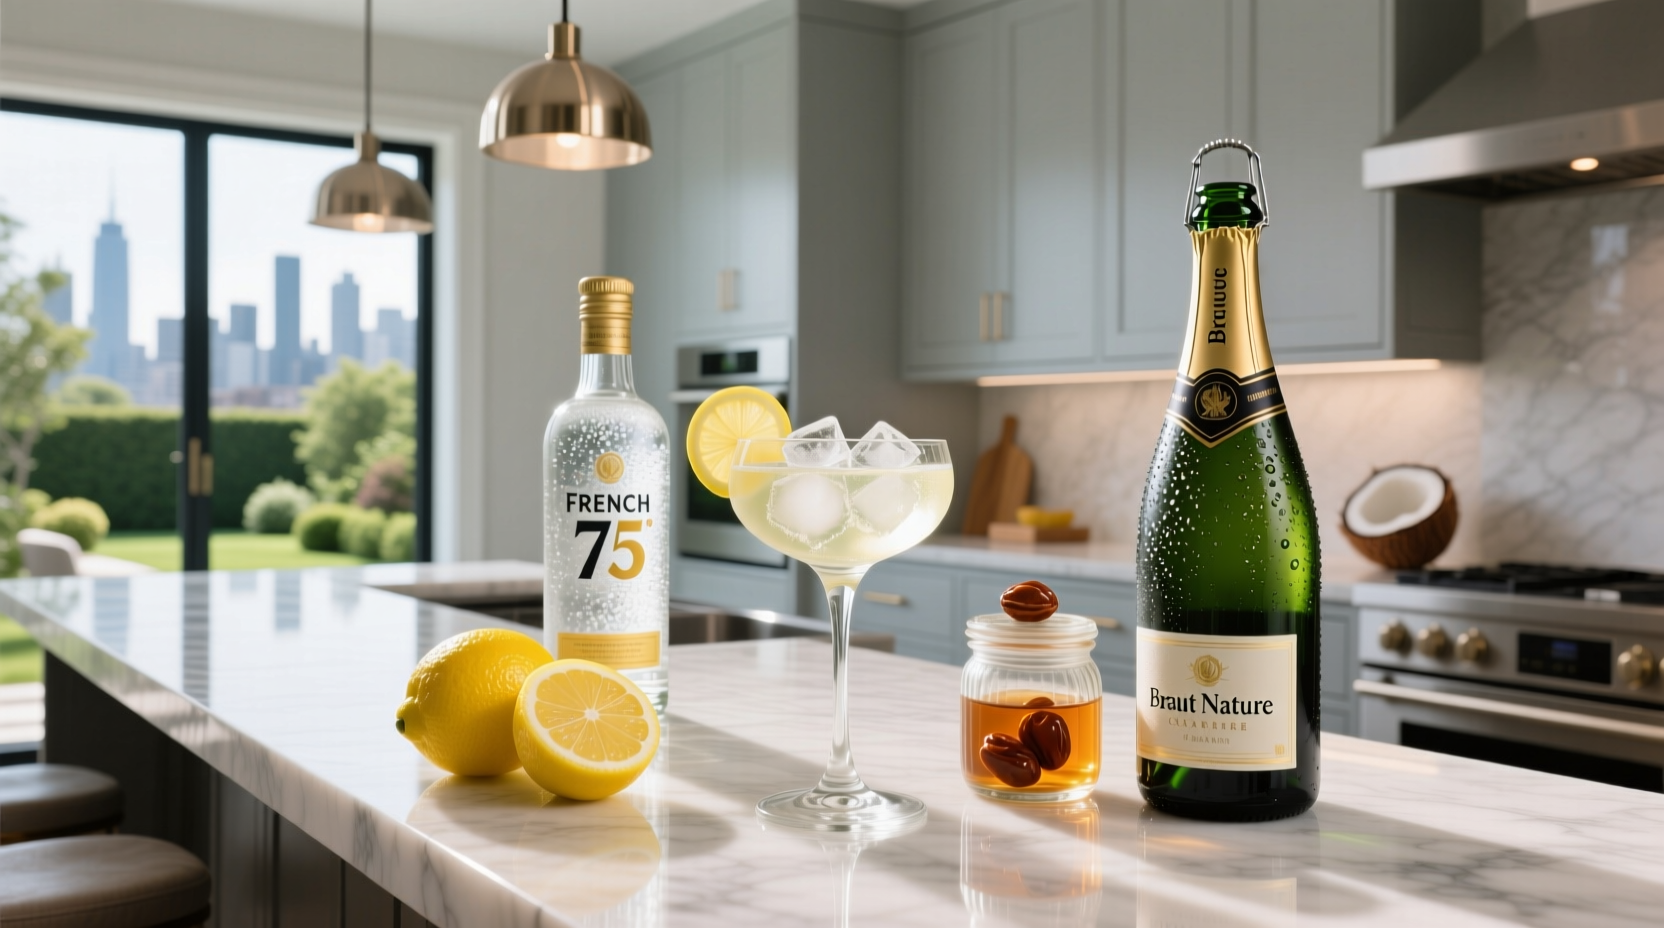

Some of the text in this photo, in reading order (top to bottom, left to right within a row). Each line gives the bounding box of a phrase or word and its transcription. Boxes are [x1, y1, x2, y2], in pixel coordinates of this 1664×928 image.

[566, 492, 650, 513] FRENCH
[574, 520, 645, 580] 75
[1150, 687, 1274, 715] Braut Nature
